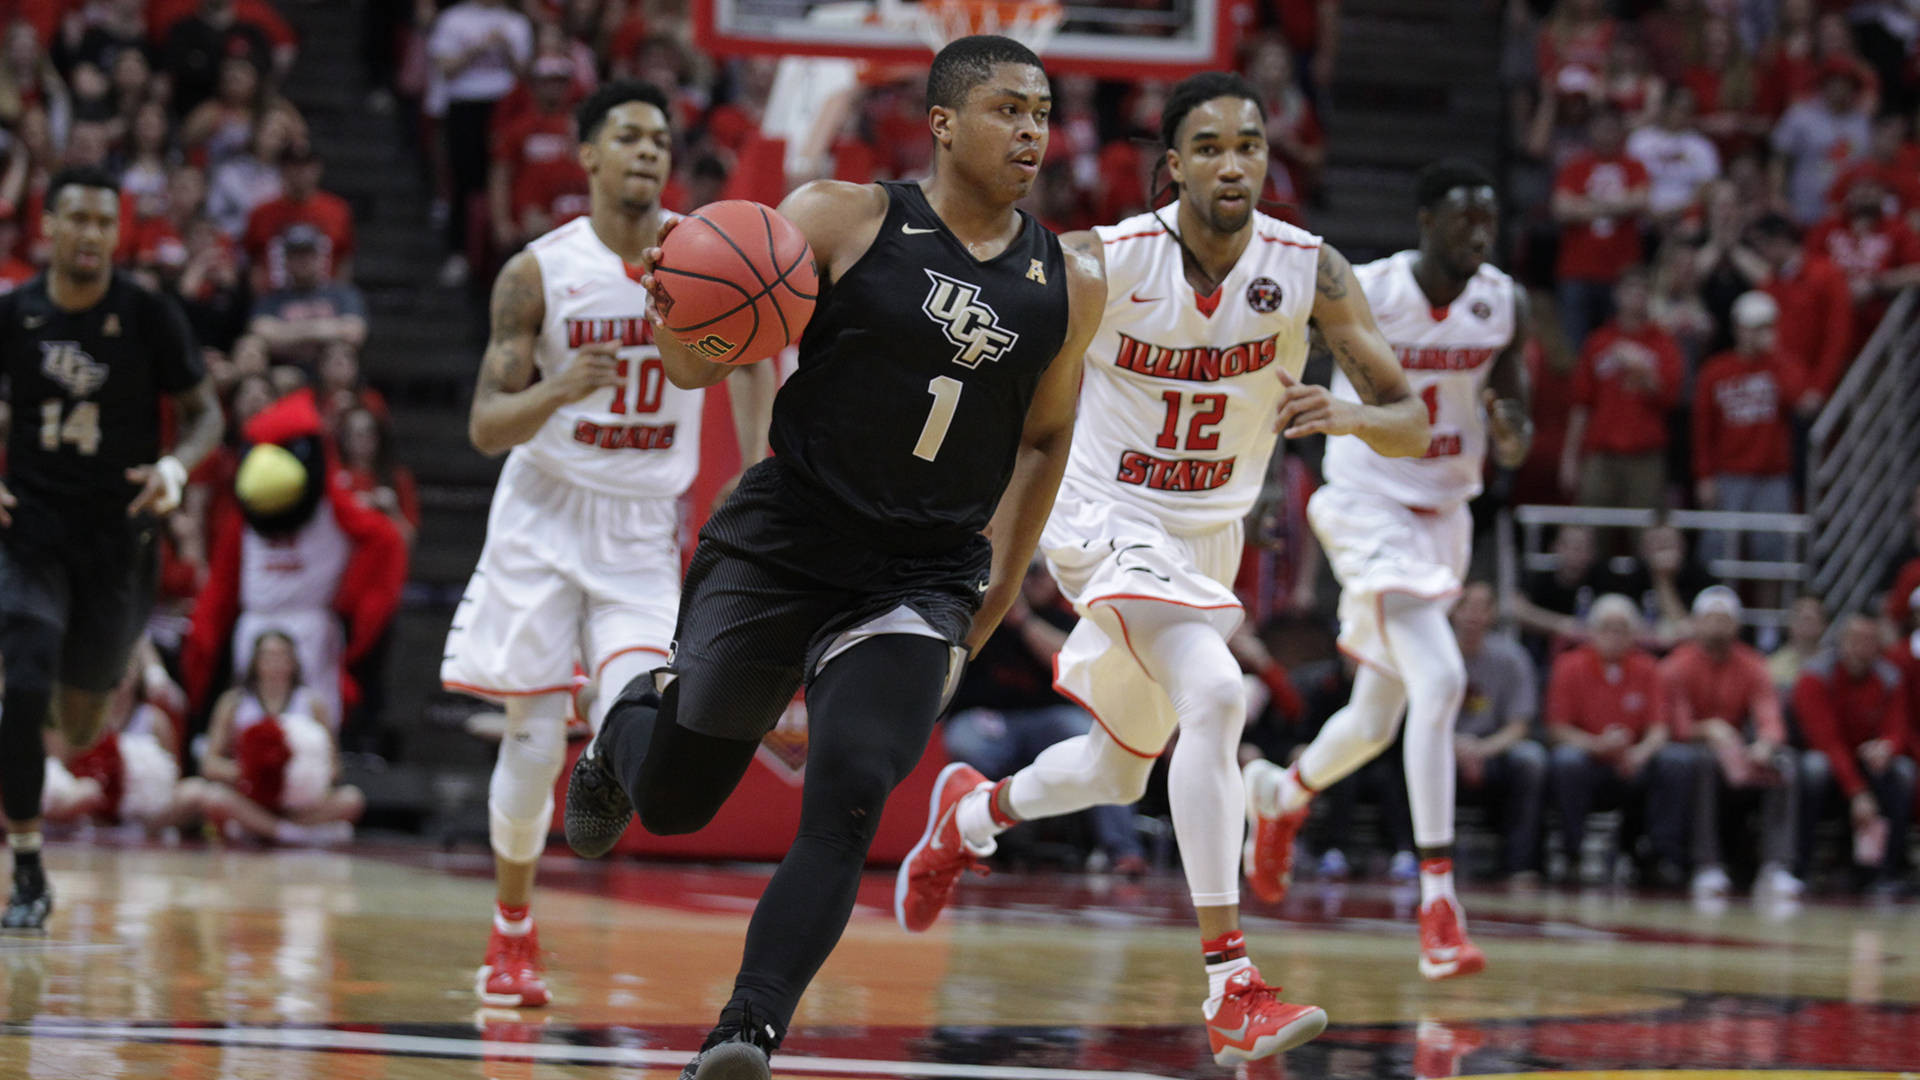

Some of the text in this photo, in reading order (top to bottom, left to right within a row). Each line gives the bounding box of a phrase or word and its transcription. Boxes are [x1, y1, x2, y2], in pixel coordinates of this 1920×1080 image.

[1025, 258, 1047, 285] A
[923, 269, 1018, 368] UCF
[1115, 331, 1280, 381] ILLINOIS
[610, 358, 666, 414] 10
[40, 399, 101, 455] 14
[573, 419, 676, 450] STATE
[912, 375, 963, 462] 1
[1156, 390, 1228, 450] 12
[1117, 449, 1237, 491] STATE
